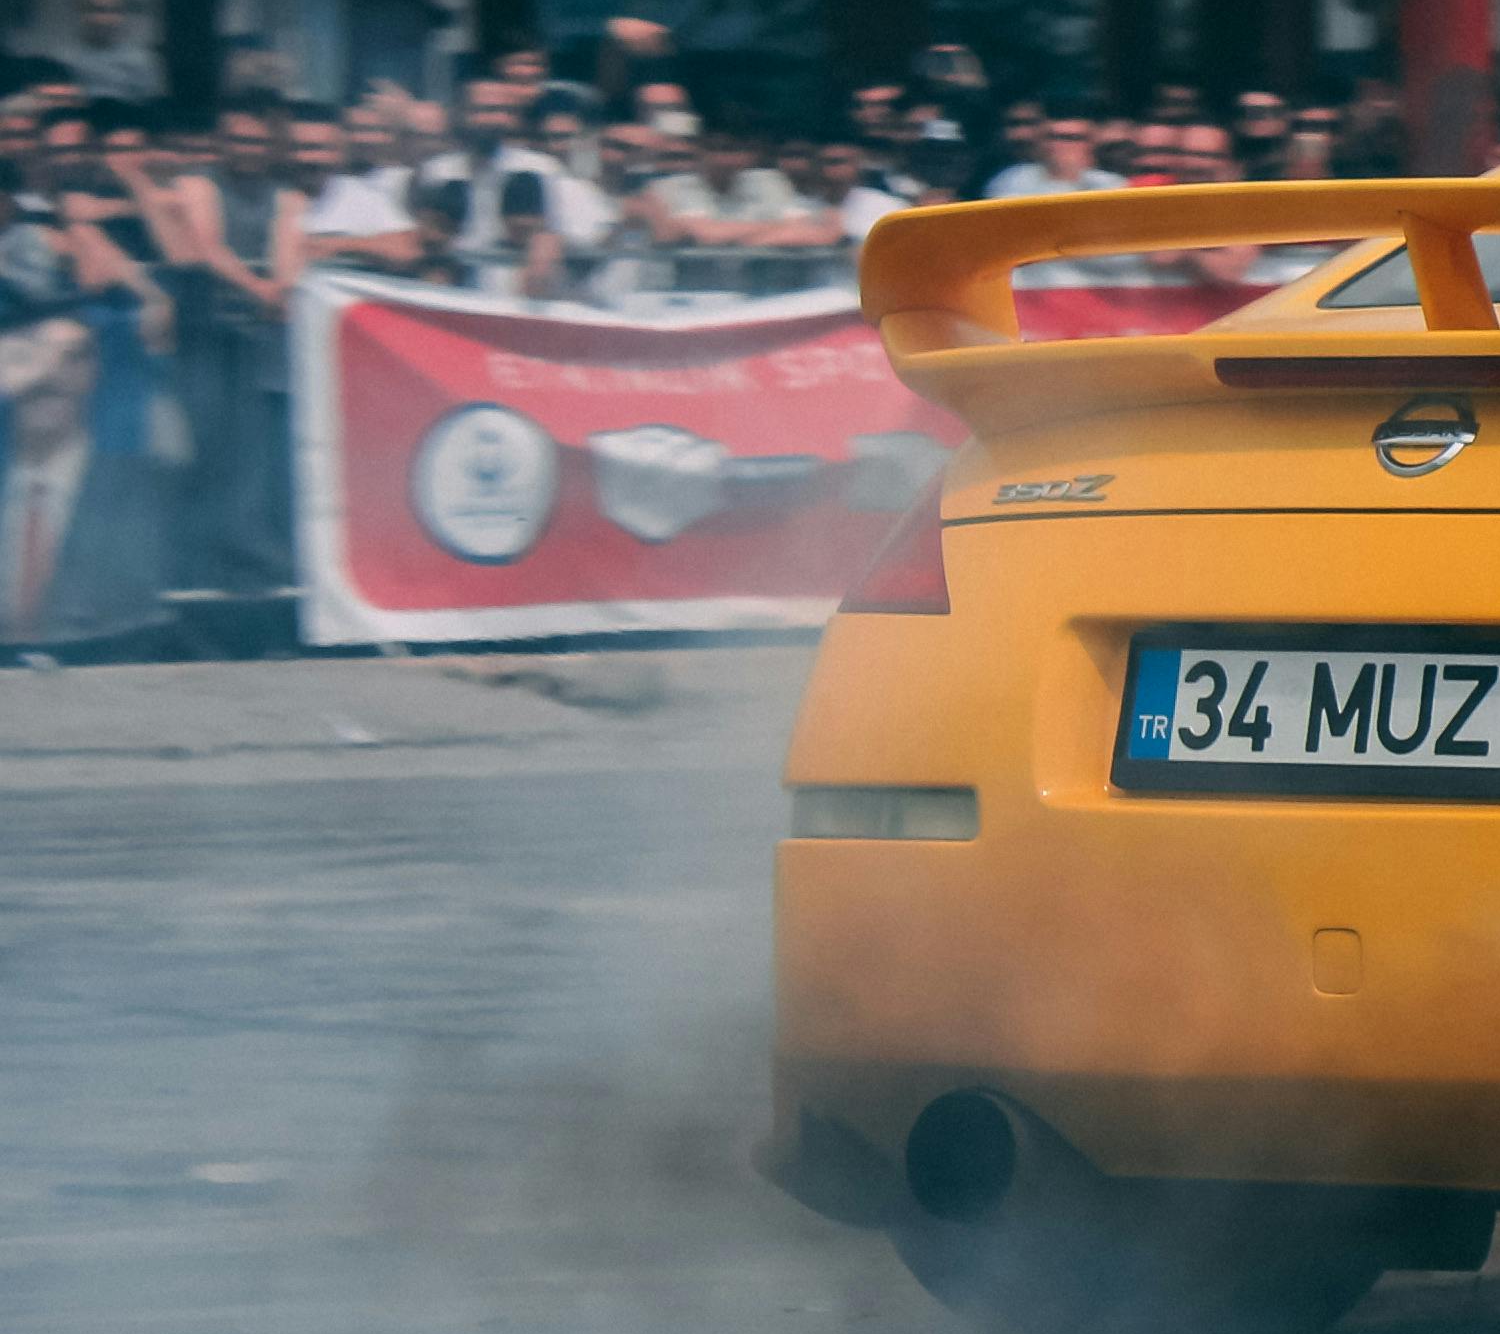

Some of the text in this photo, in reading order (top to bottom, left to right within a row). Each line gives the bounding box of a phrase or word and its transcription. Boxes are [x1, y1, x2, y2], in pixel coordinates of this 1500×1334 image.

[991, 474, 1116, 505] 350Z
[1139, 715, 1168, 739] TR
[1178, 660, 1273, 752] 34
[1304, 662, 1499, 756] MUZ
